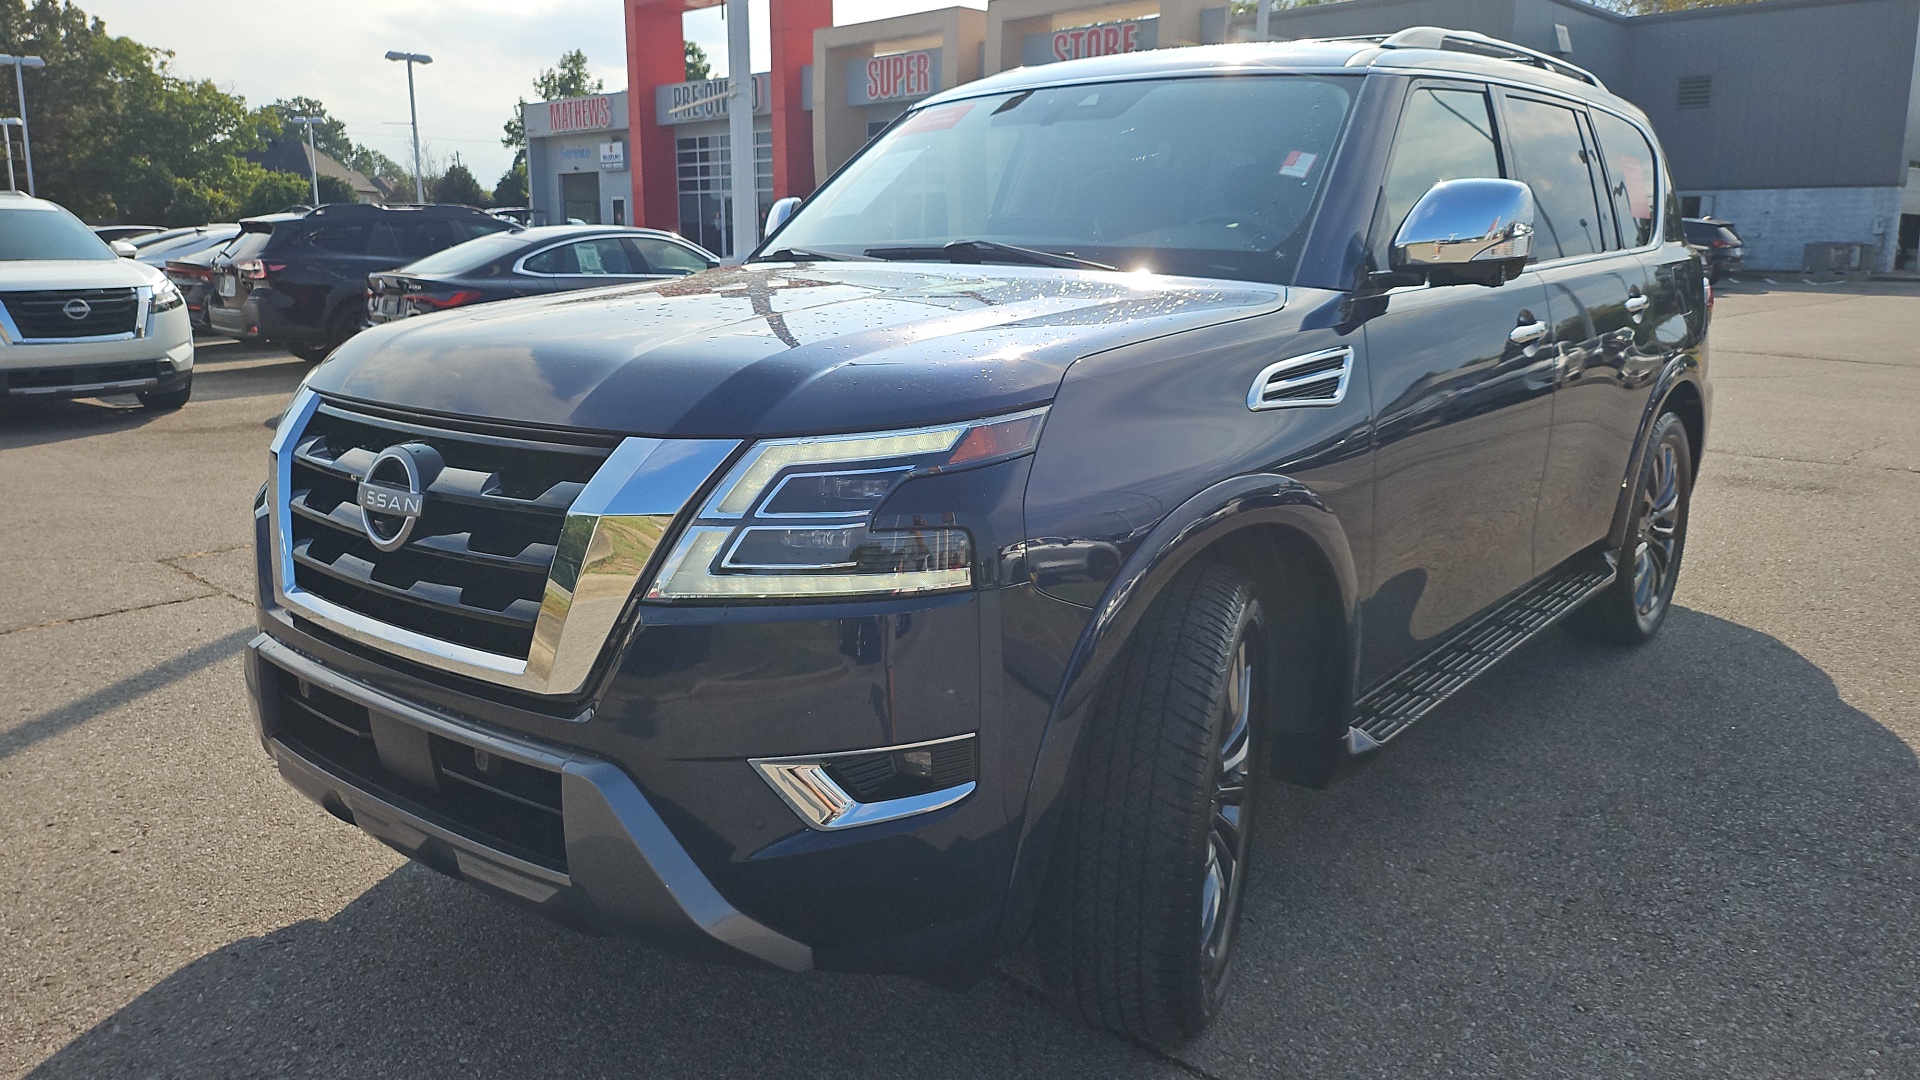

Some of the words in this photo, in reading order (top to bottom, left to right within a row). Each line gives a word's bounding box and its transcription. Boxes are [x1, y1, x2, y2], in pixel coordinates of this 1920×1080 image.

[704, 76, 759, 116] OWD
[867, 53, 930, 99] SUPER
[550, 97, 609, 132] MATHEWS
